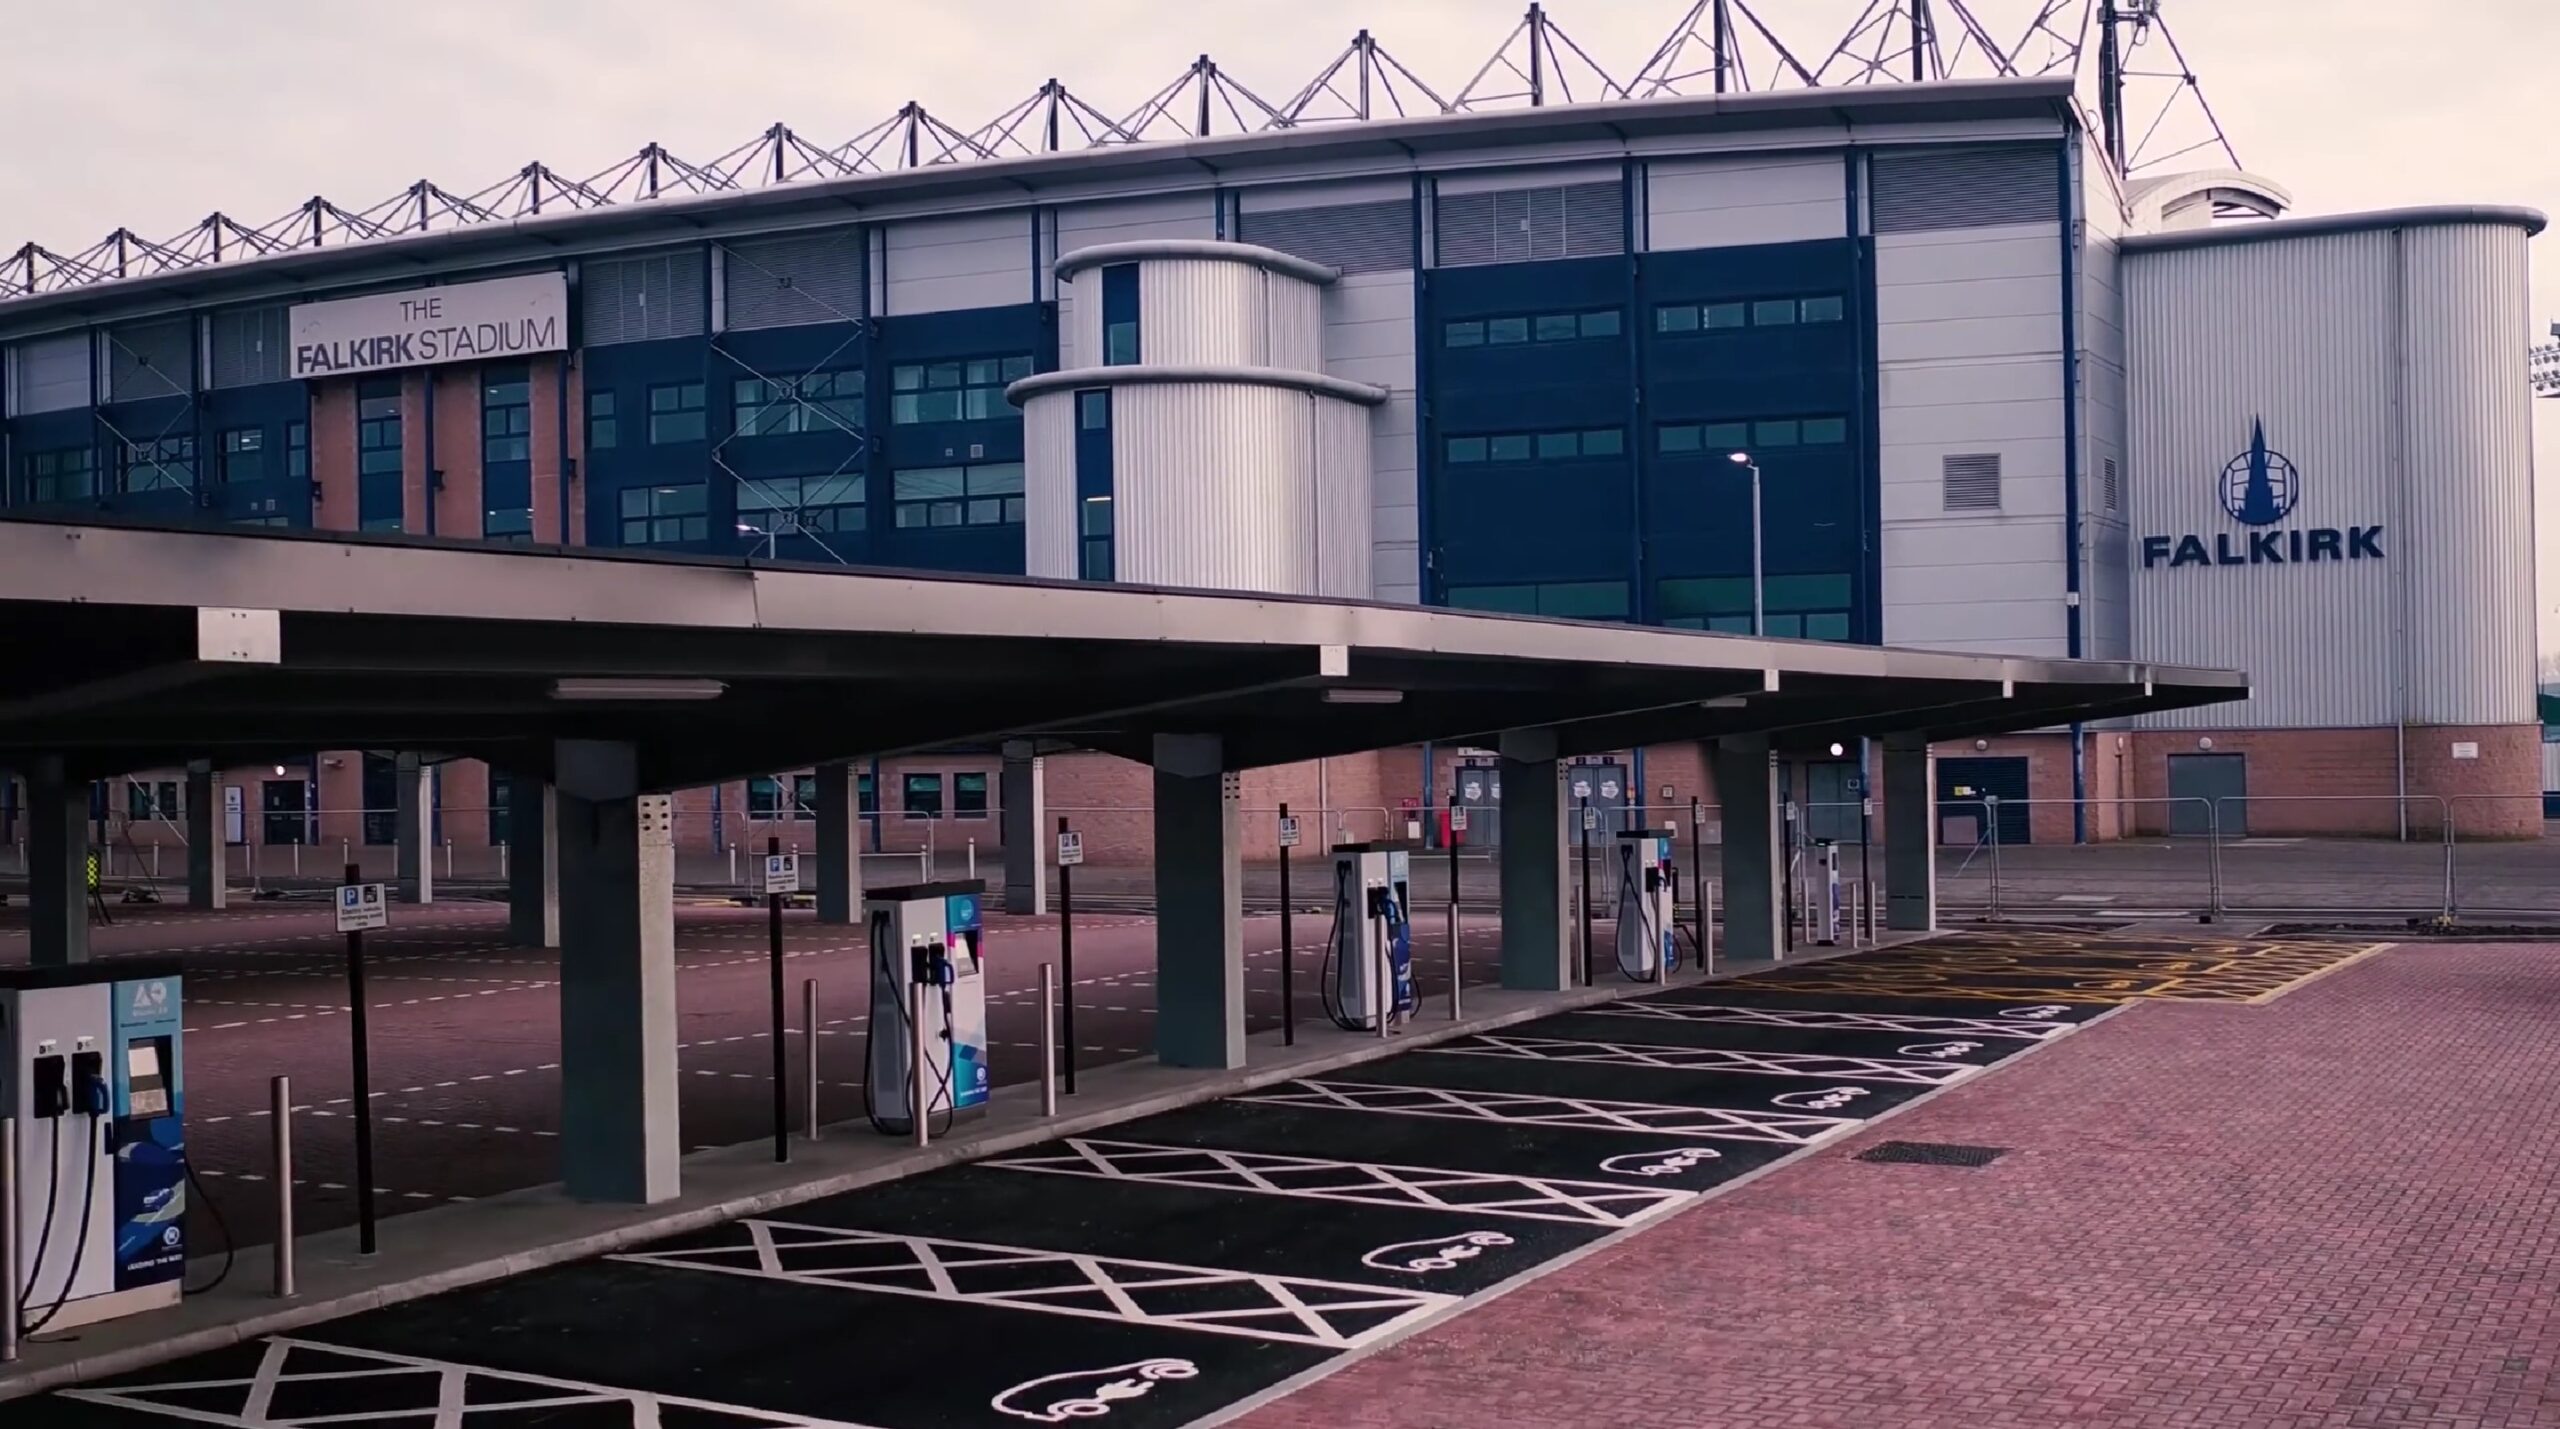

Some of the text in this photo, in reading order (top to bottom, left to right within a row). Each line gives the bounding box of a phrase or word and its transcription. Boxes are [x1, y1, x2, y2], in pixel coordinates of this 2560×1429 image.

[400, 298, 442, 322] THE
[297, 316, 555, 374] FALKIRK STADIUM
[2143, 525, 2386, 568] FALKIRK
[346, 890, 355, 904] P
